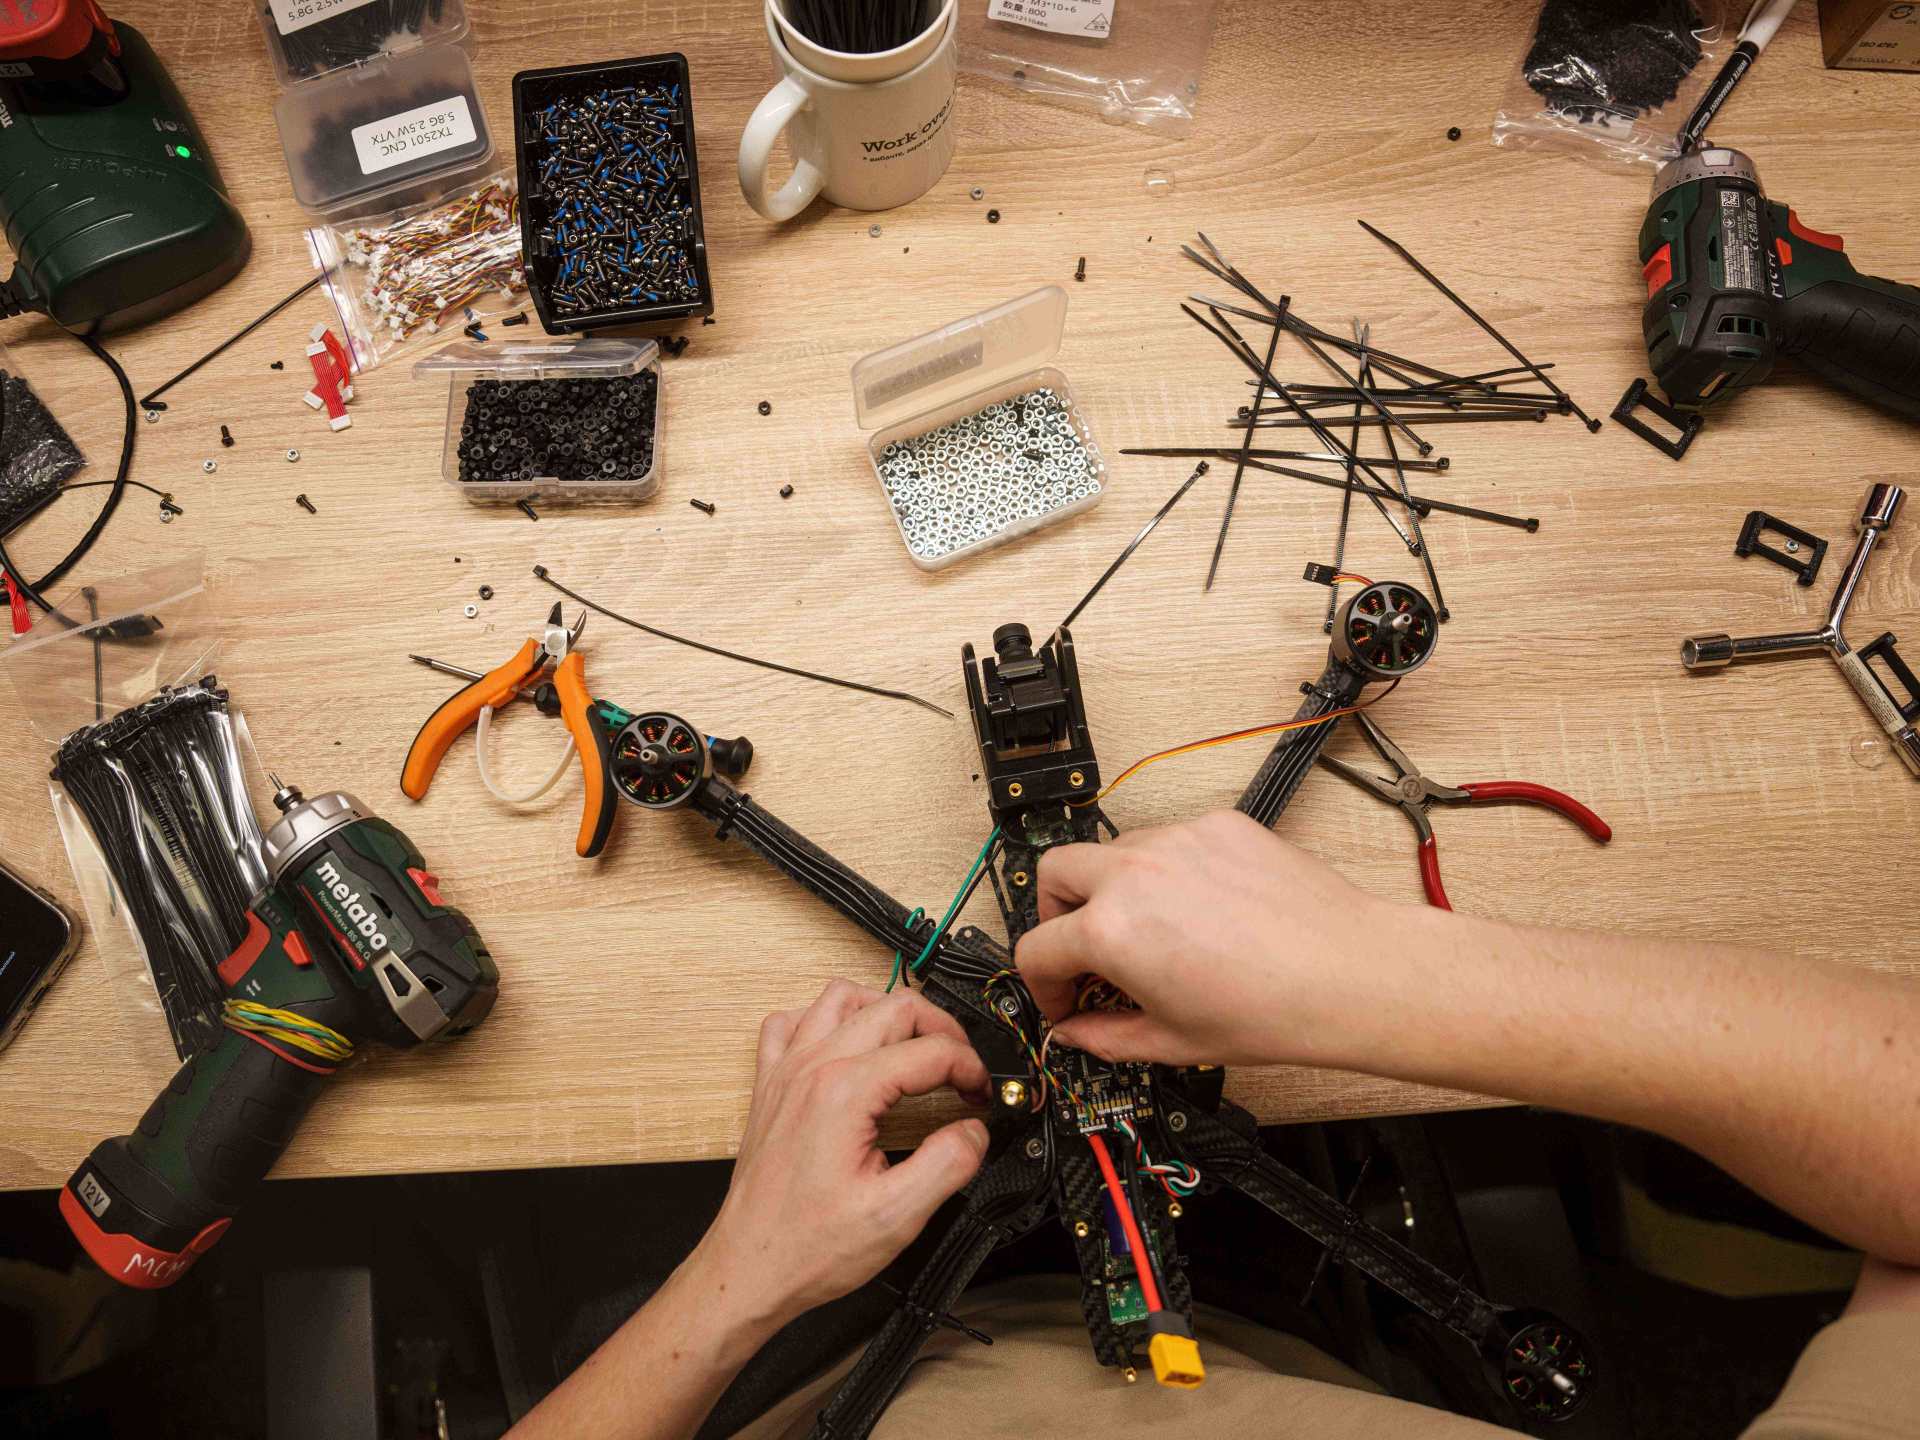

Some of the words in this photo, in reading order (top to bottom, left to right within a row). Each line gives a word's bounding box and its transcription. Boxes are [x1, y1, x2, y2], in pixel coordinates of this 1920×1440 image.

[288, 5, 313, 21] 5.8G
[428, 111, 455, 127] 5.8G
[370, 130, 395, 146] VTX
[398, 120, 425, 138] 2.5W
[411, 126, 453, 147] TX2501
[381, 140, 407, 157] CNC
[861, 131, 918, 153] Work
[315, 861, 388, 951] metabo
[83, 1180, 106, 1209] 12V
